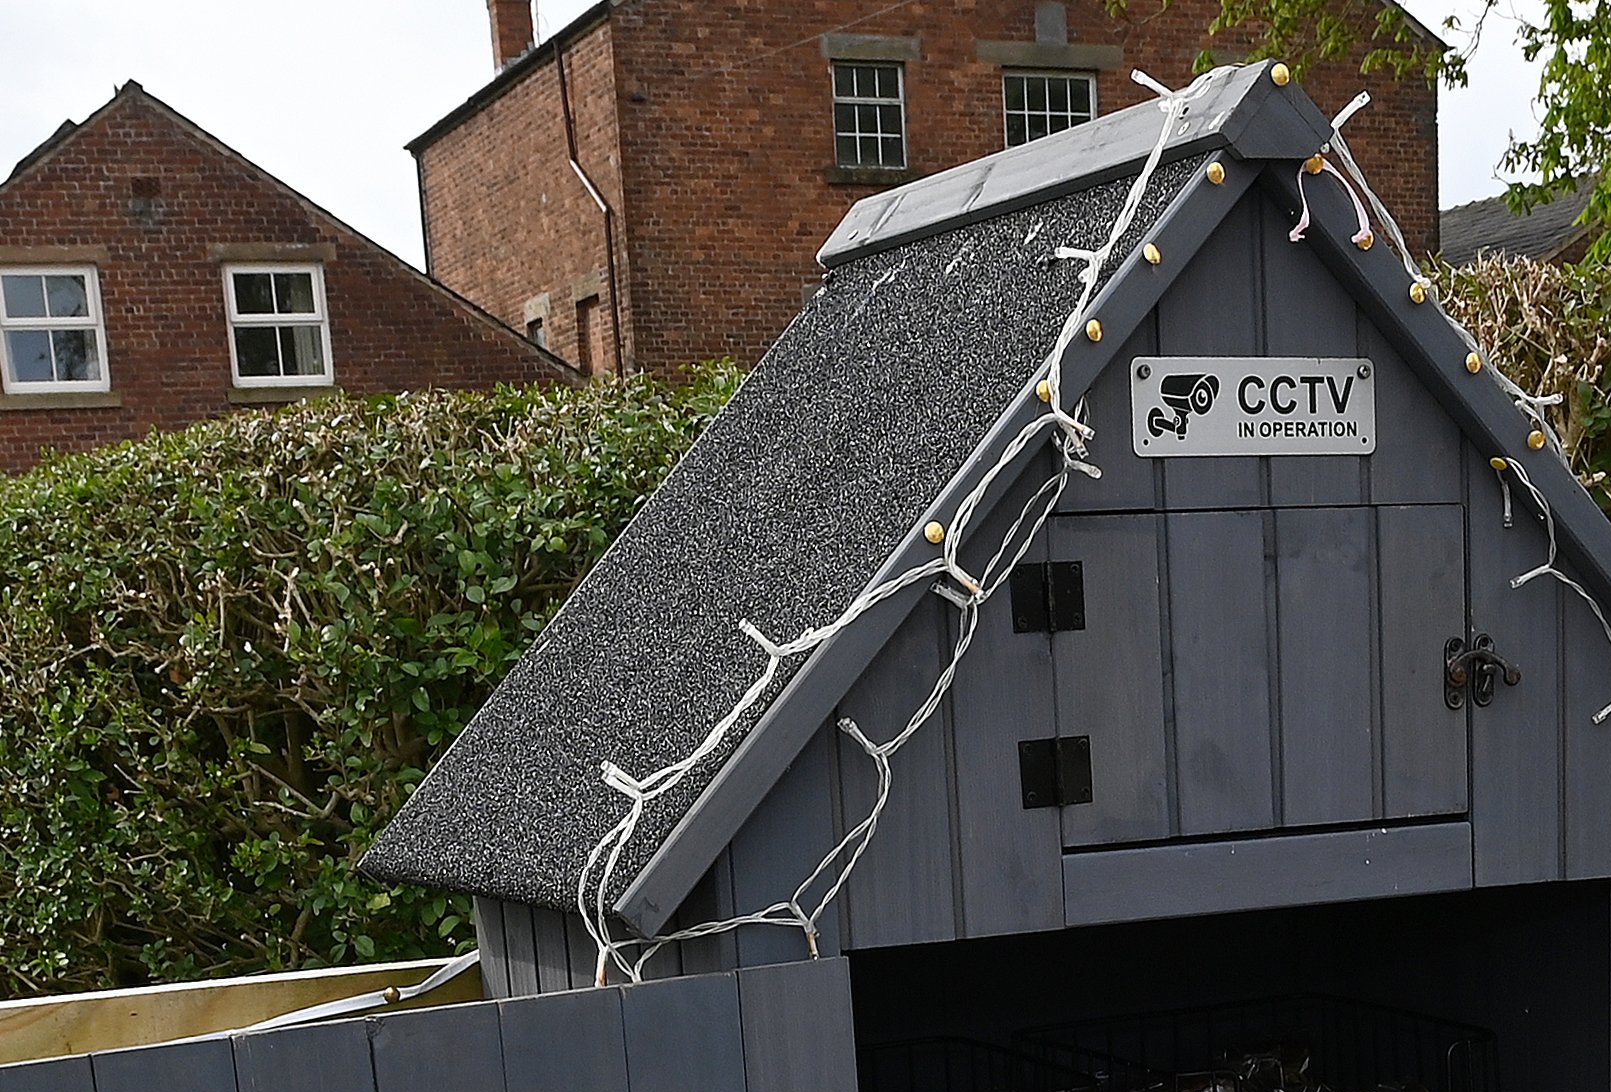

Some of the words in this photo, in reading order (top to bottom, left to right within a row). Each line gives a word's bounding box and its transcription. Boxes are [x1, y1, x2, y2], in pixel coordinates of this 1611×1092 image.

[1237, 375, 1354, 415] CCTV
[1238, 422, 1254, 438] IN
[1259, 421, 1357, 438] OPERATION
